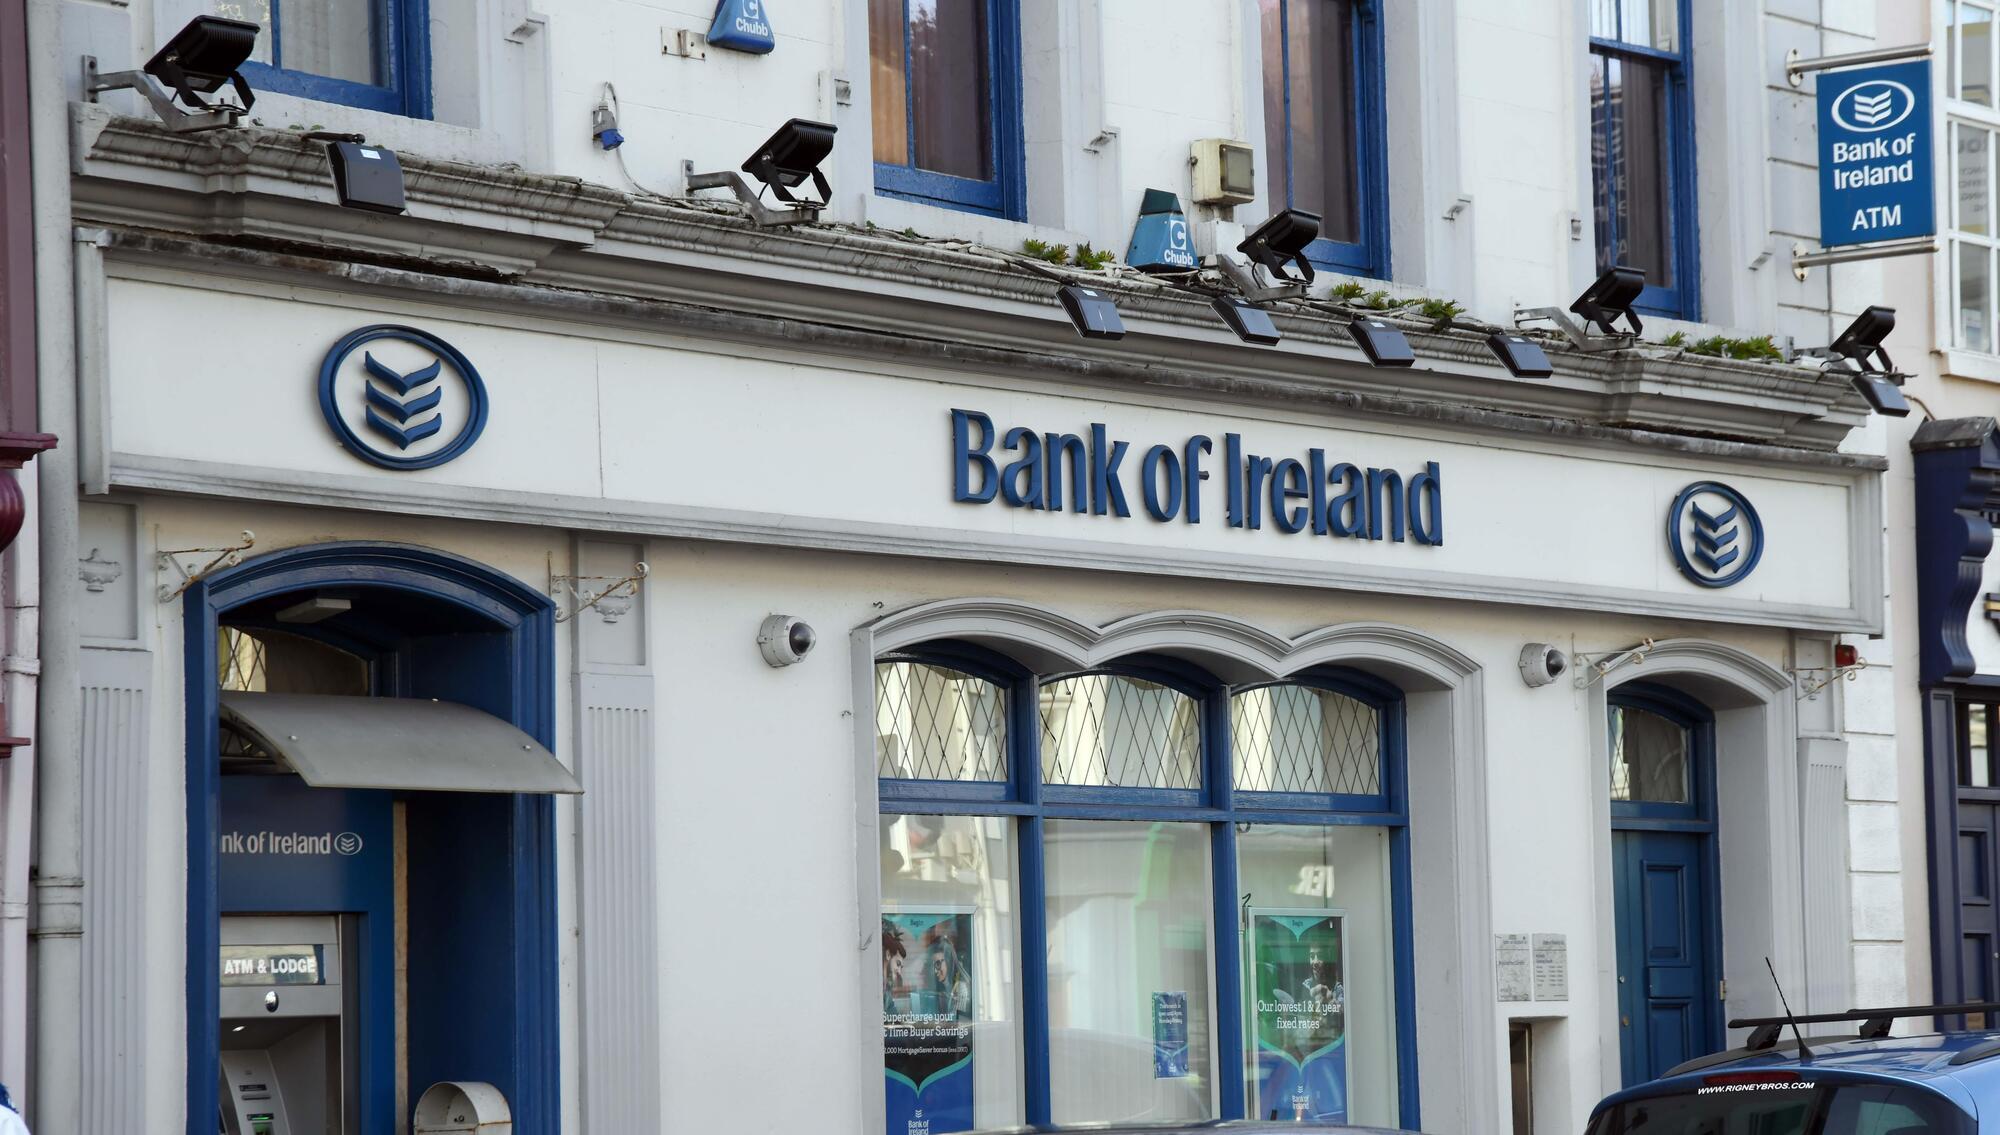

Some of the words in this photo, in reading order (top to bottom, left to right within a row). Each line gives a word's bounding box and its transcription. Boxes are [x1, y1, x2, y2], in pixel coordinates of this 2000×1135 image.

[735, 17, 769, 37] Chubb
[1833, 137, 1889, 164] Bank
[1892, 133, 1916, 156] of
[1833, 160, 1913, 190] Ireland
[1851, 204, 1901, 231] ATM
[1163, 249, 1194, 266] Chubb
[950, 408, 1131, 518] Bank
[1141, 434, 1213, 524] of
[1225, 433, 1443, 547] Ireland
[221, 831, 244, 853] nk
[247, 831, 267, 854] of
[269, 832, 331, 855] Ireland
[224, 958, 253, 974] ATM
[257, 959, 267, 973] &
[270, 957, 316, 974] LODGE
[1257, 1000, 1274, 1012] Our
[1275, 1000, 1301, 1012] lowest
[1307, 1001, 1314, 1012] &
[1315, 1001, 1321, 1012] 2
[1322, 1003, 1341, 1016] year
[882, 1010, 933, 1025] Supercharge
[934, 1012, 955, 1025] your
[1276, 1017, 1297, 1029] fixed
[889, 1026, 909, 1037] Time
[909, 1026, 935, 1040] Buyer
[935, 1025, 969, 1039] Savings
[1697, 1082, 1816, 1096] WWW.RIGNEYBROS.COM
[908, 1120, 922, 1129] Bank
